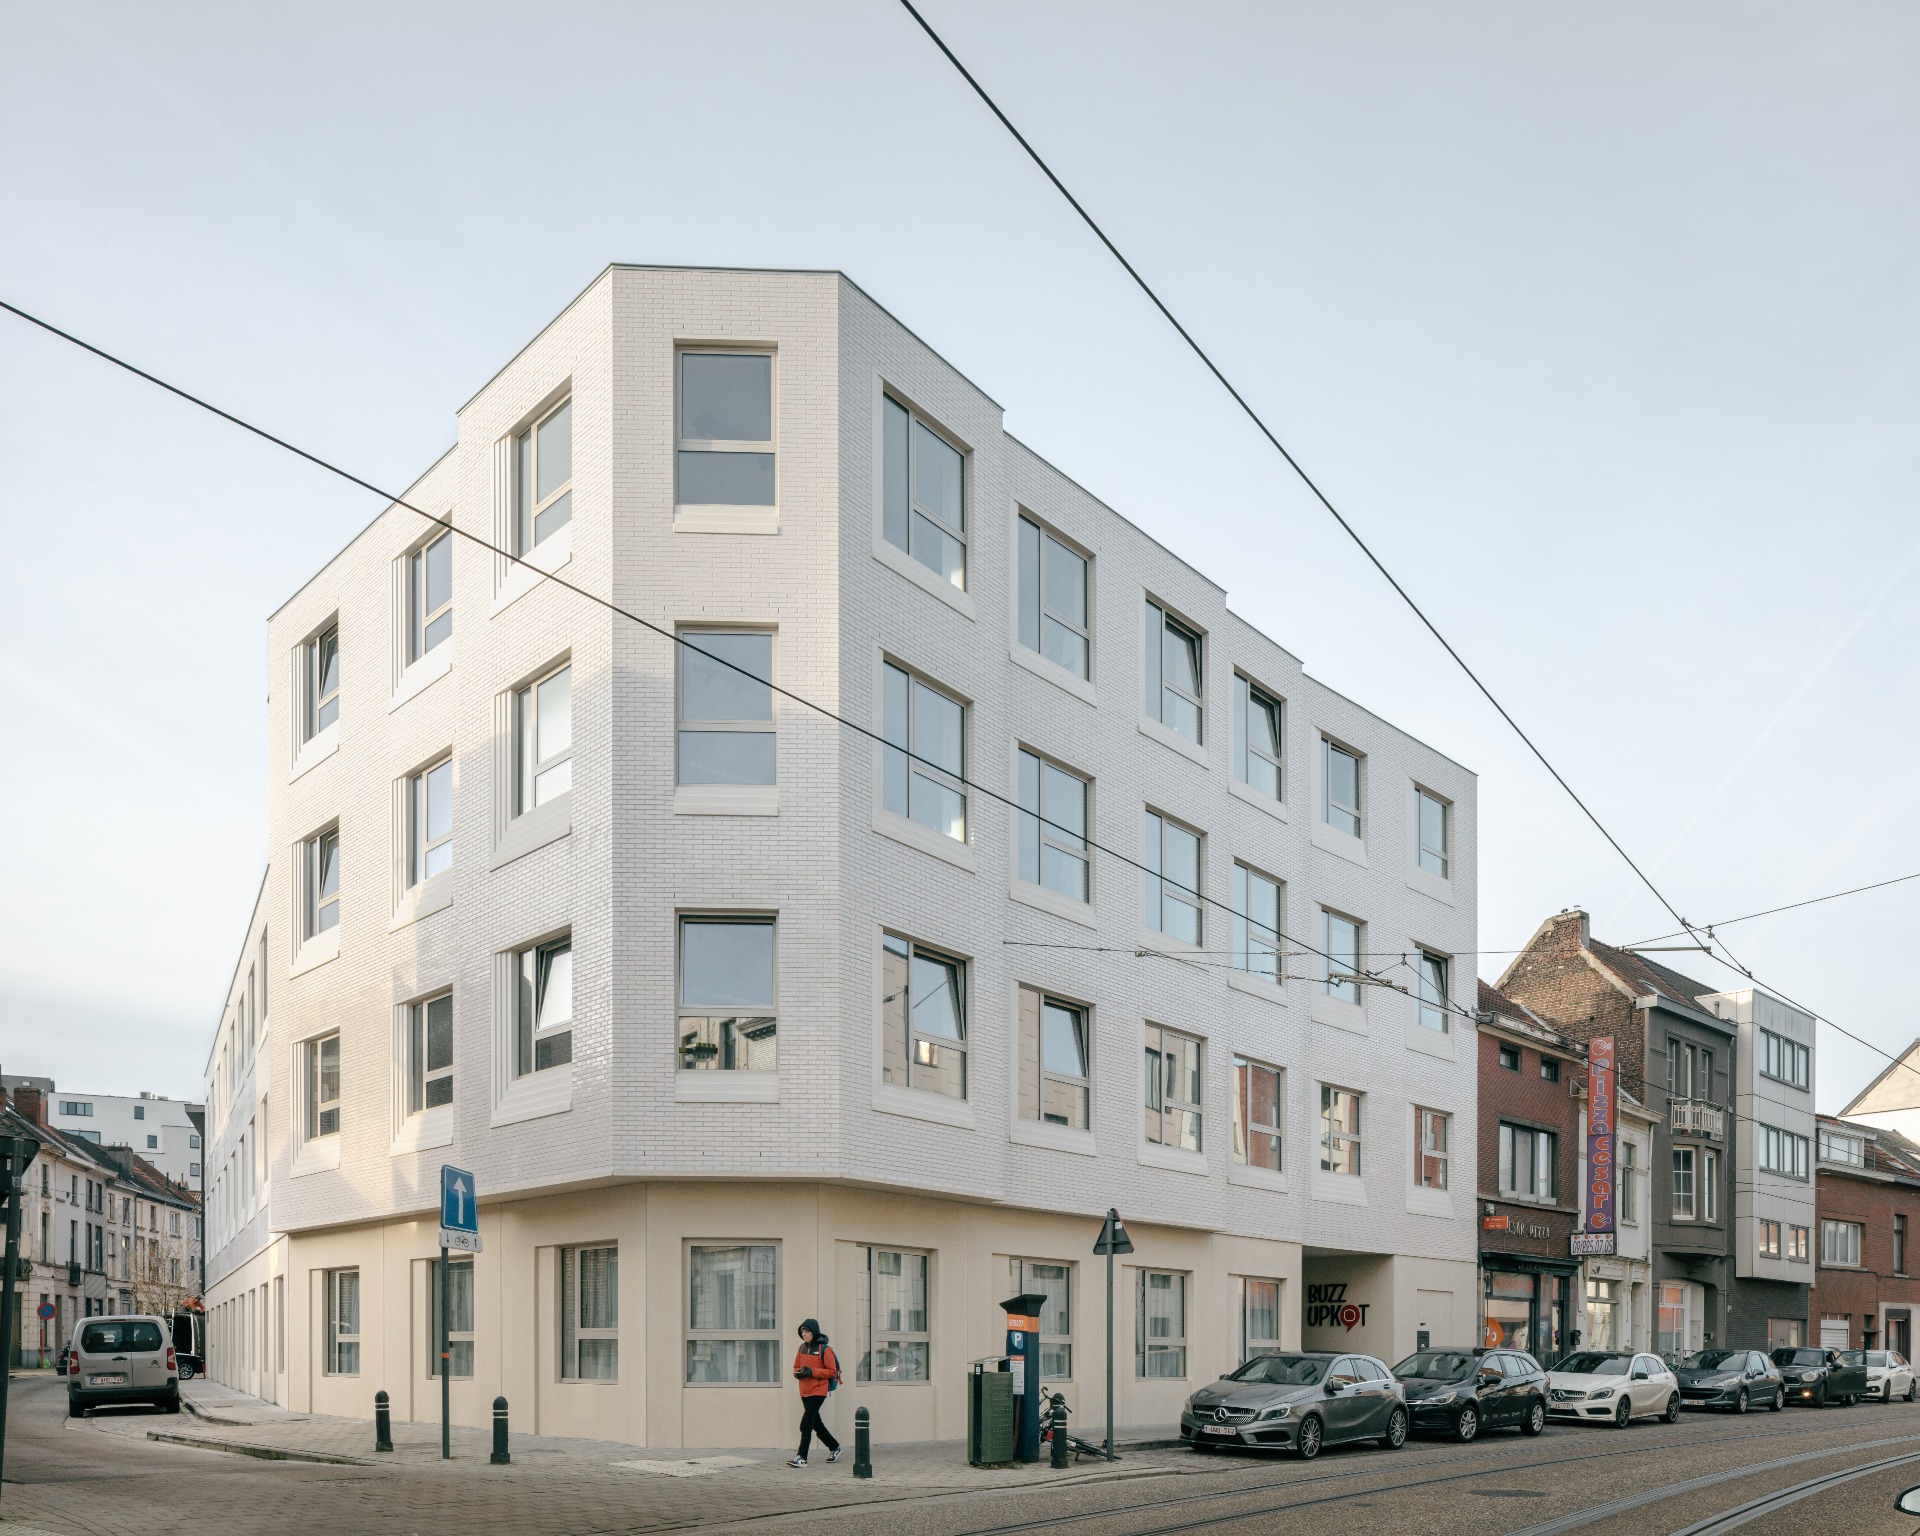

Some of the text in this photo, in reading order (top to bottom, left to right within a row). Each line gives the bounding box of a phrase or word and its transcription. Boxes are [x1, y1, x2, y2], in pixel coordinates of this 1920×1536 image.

[1529, 1224, 1550, 1239] PIZZA
[1307, 1283, 1348, 1303] BUZZ
[1307, 1304, 1370, 1332] UPKOT
[1014, 1332, 1022, 1347] P
